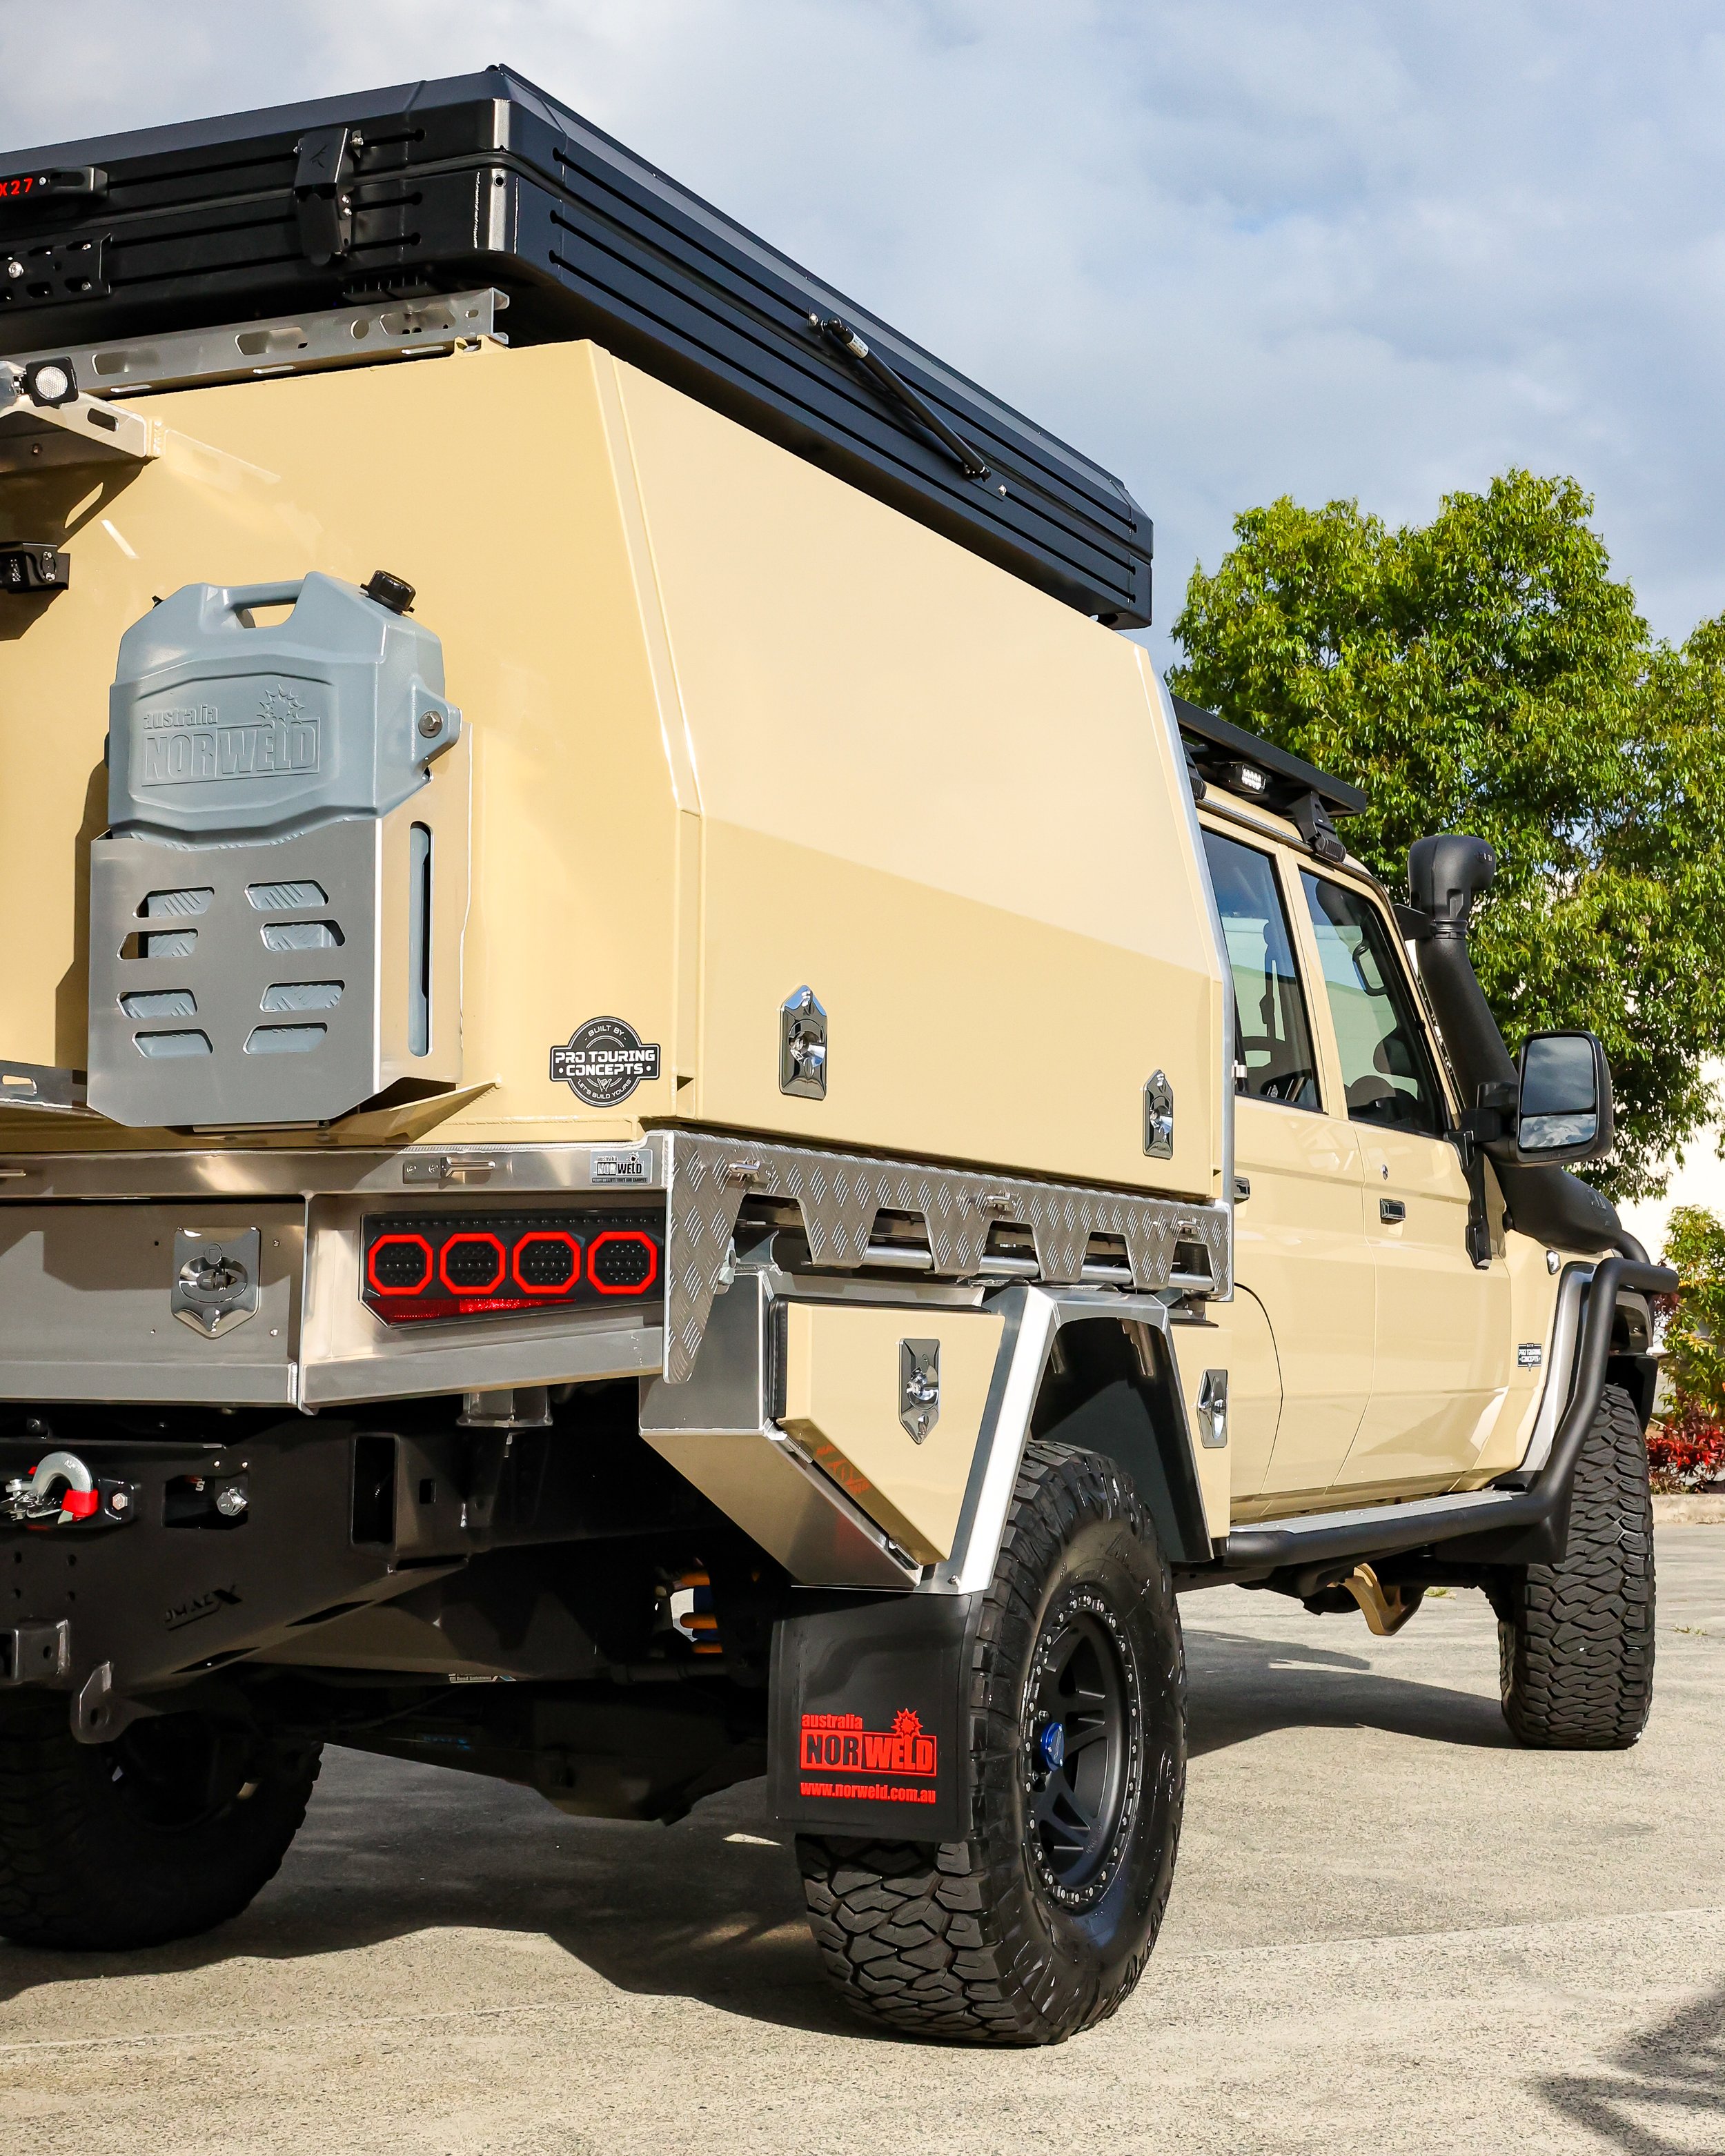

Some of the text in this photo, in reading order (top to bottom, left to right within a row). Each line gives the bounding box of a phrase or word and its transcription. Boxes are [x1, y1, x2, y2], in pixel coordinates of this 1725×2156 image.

[143, 704, 218, 729] australia
[588, 1025, 624, 1038] BUILT BY
[555, 1049, 656, 1064] PRO TOURING
[566, 1063, 644, 1076] CONCEPTS
[591, 1091, 611, 1100] BUILD
[801, 1713, 863, 1730] australia
[805, 1732, 934, 1772] NORWELD
[800, 1782, 936, 1803] www.norweld.com.au
